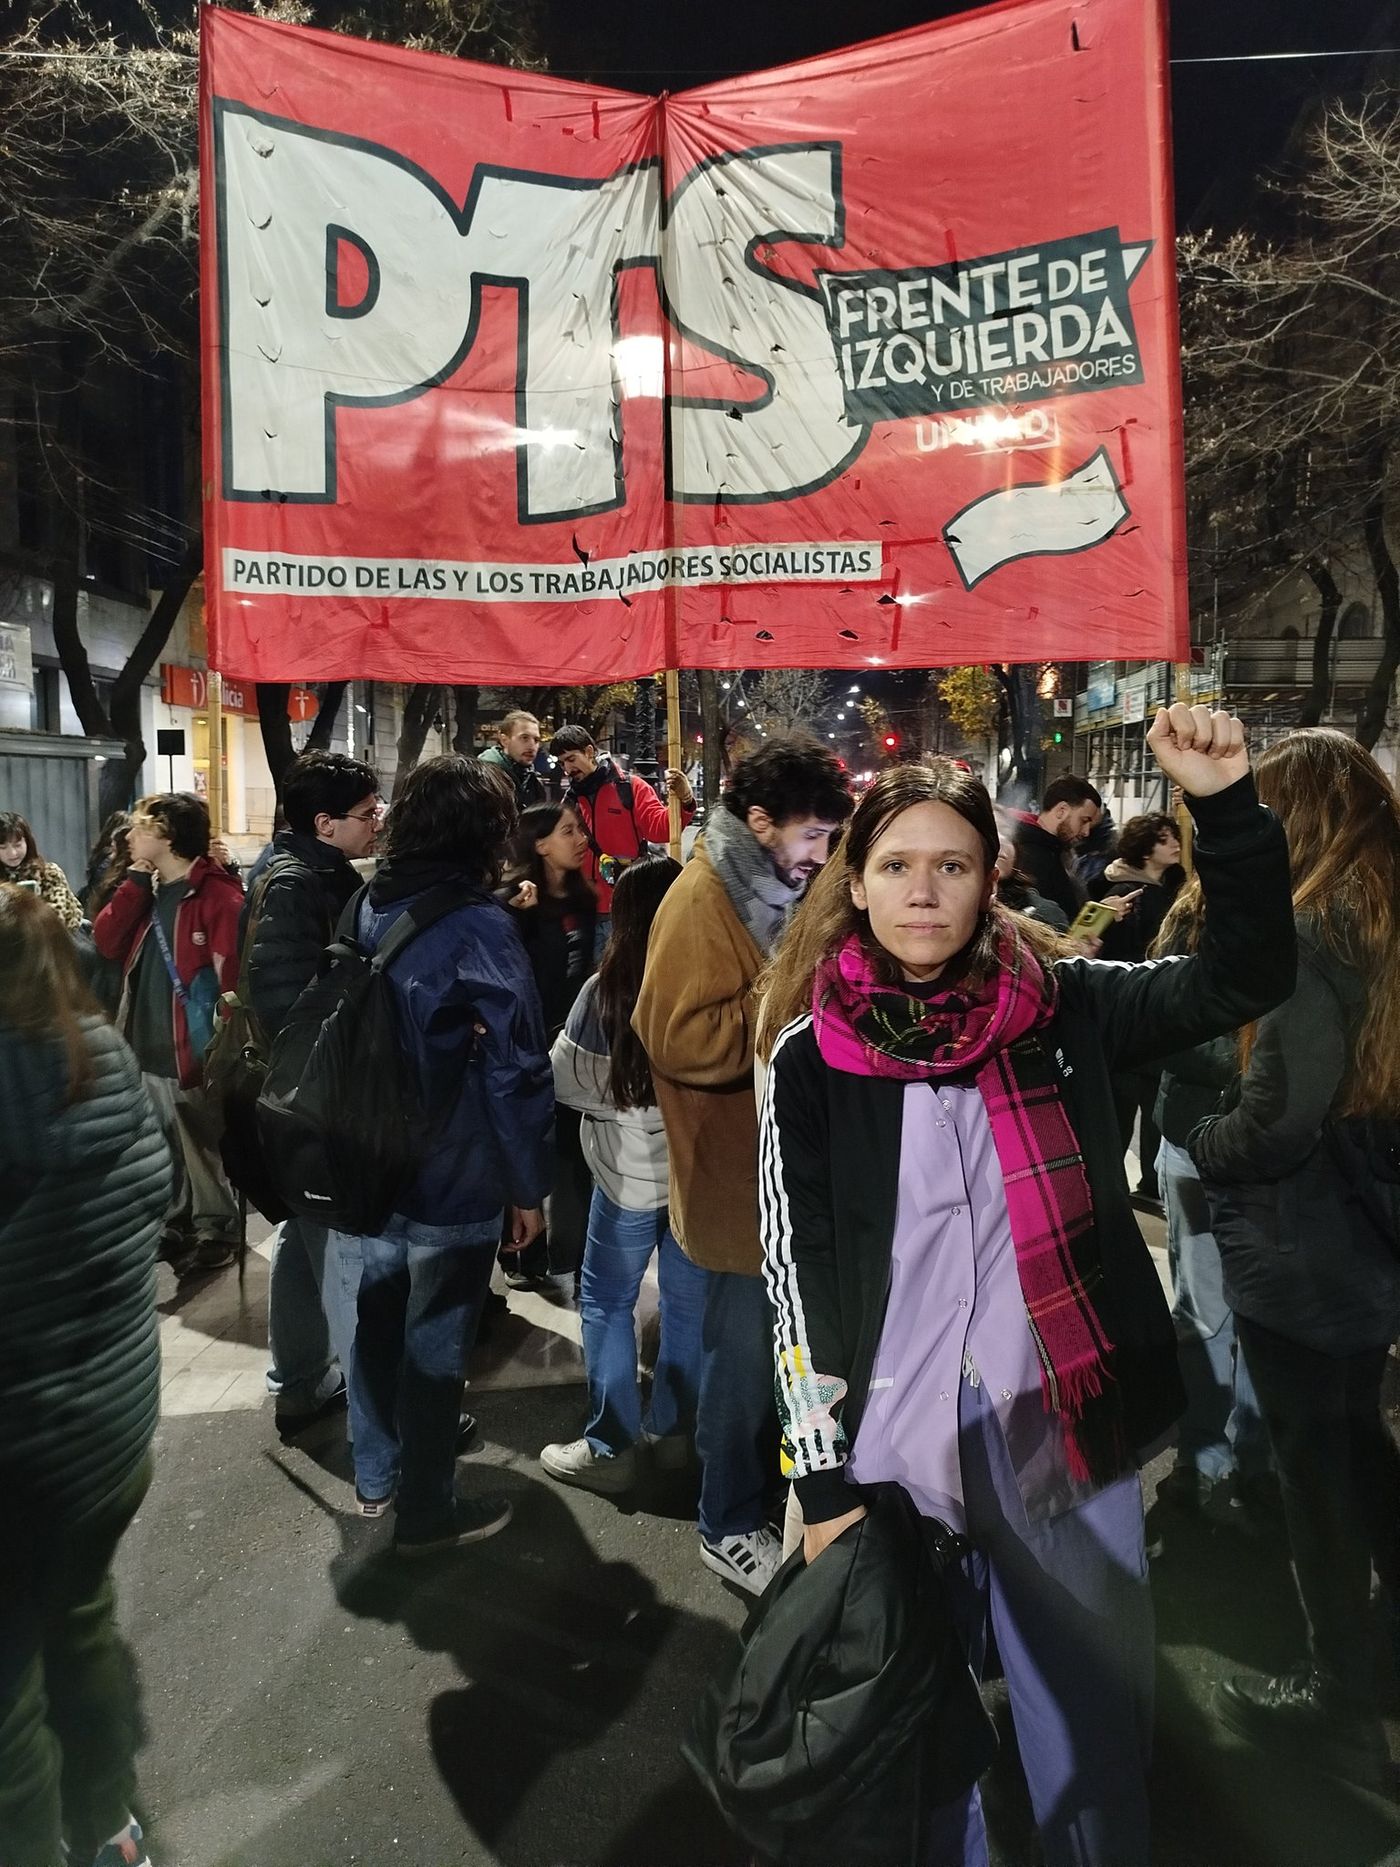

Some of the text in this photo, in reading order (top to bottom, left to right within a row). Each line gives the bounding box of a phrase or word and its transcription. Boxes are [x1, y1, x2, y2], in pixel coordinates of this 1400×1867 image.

[213, 97, 871, 526] PTS
[837, 248, 1109, 338] FRENTE DE
[841, 295, 1132, 391] IZQUIERDA
[931, 353, 1137, 402] Y DE TRABAJADORES
[233, 550, 873, 594] PARTIDO DE LAS Y LOS TRABAJADORES SOCIALISTAS
[216, 681, 244, 708] licia
